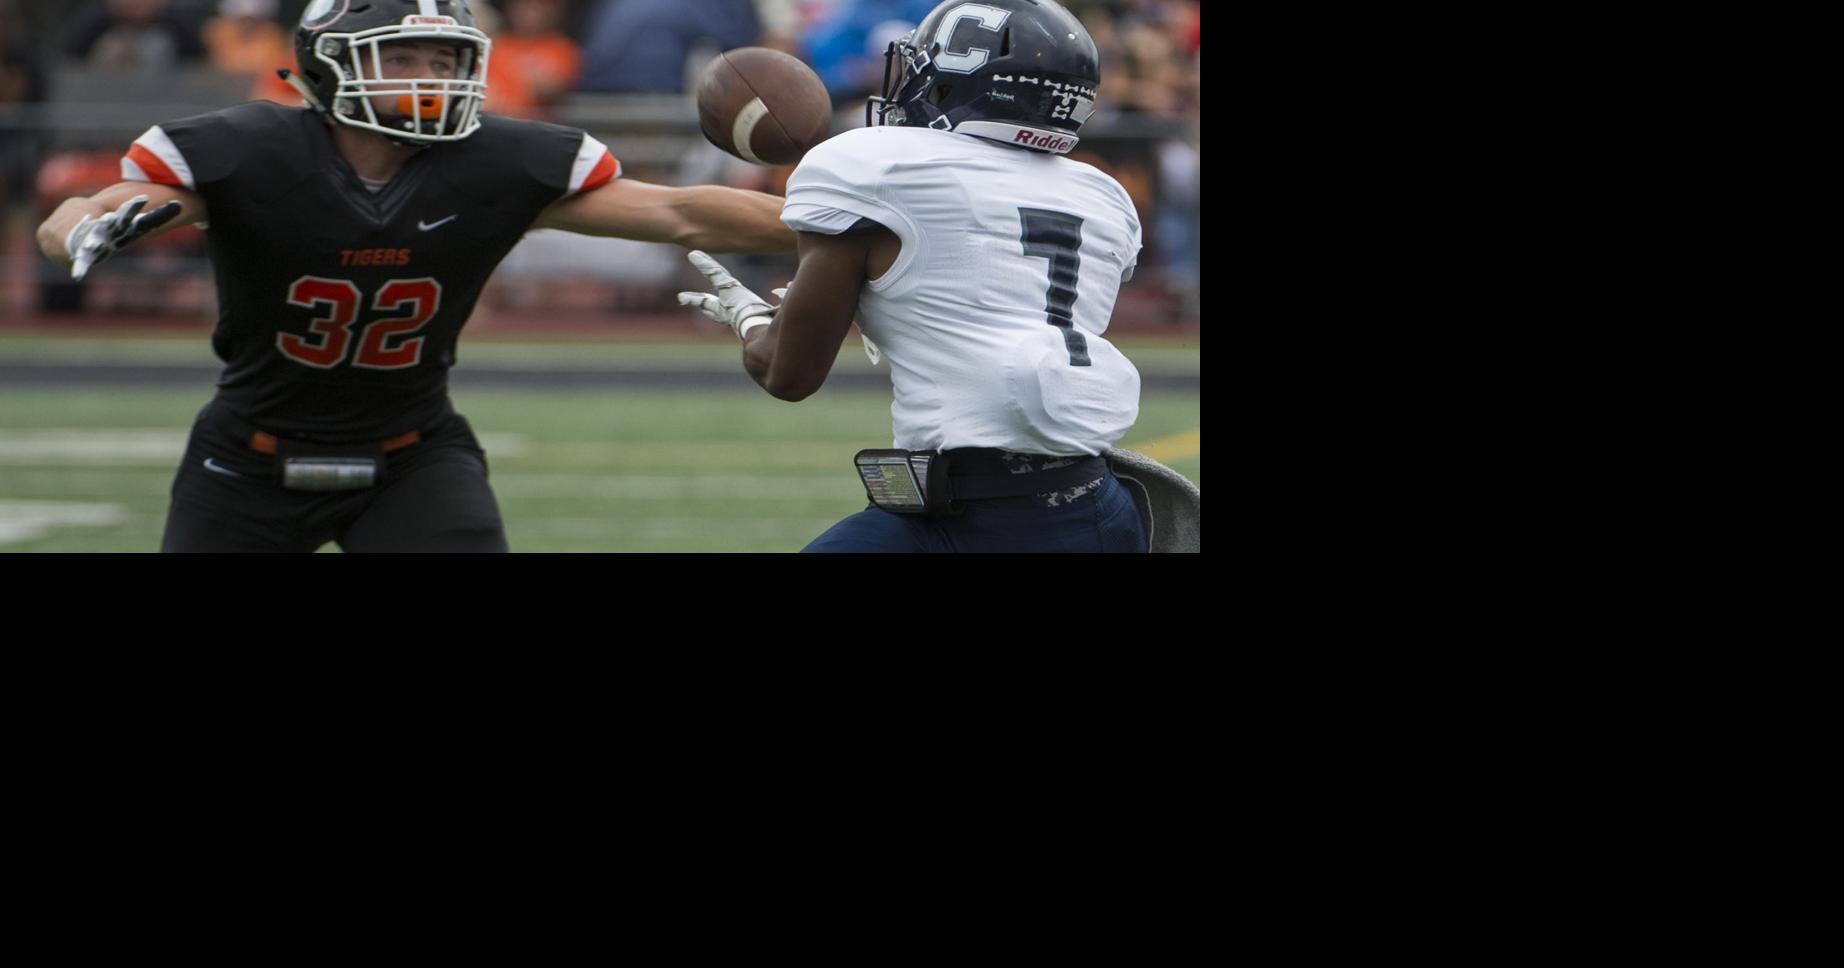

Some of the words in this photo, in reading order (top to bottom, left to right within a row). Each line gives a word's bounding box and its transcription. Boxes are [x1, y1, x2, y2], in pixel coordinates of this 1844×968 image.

[932, 2, 1012, 75] C
[339, 247, 411, 267] TIGERS
[275, 275, 442, 369] 32
